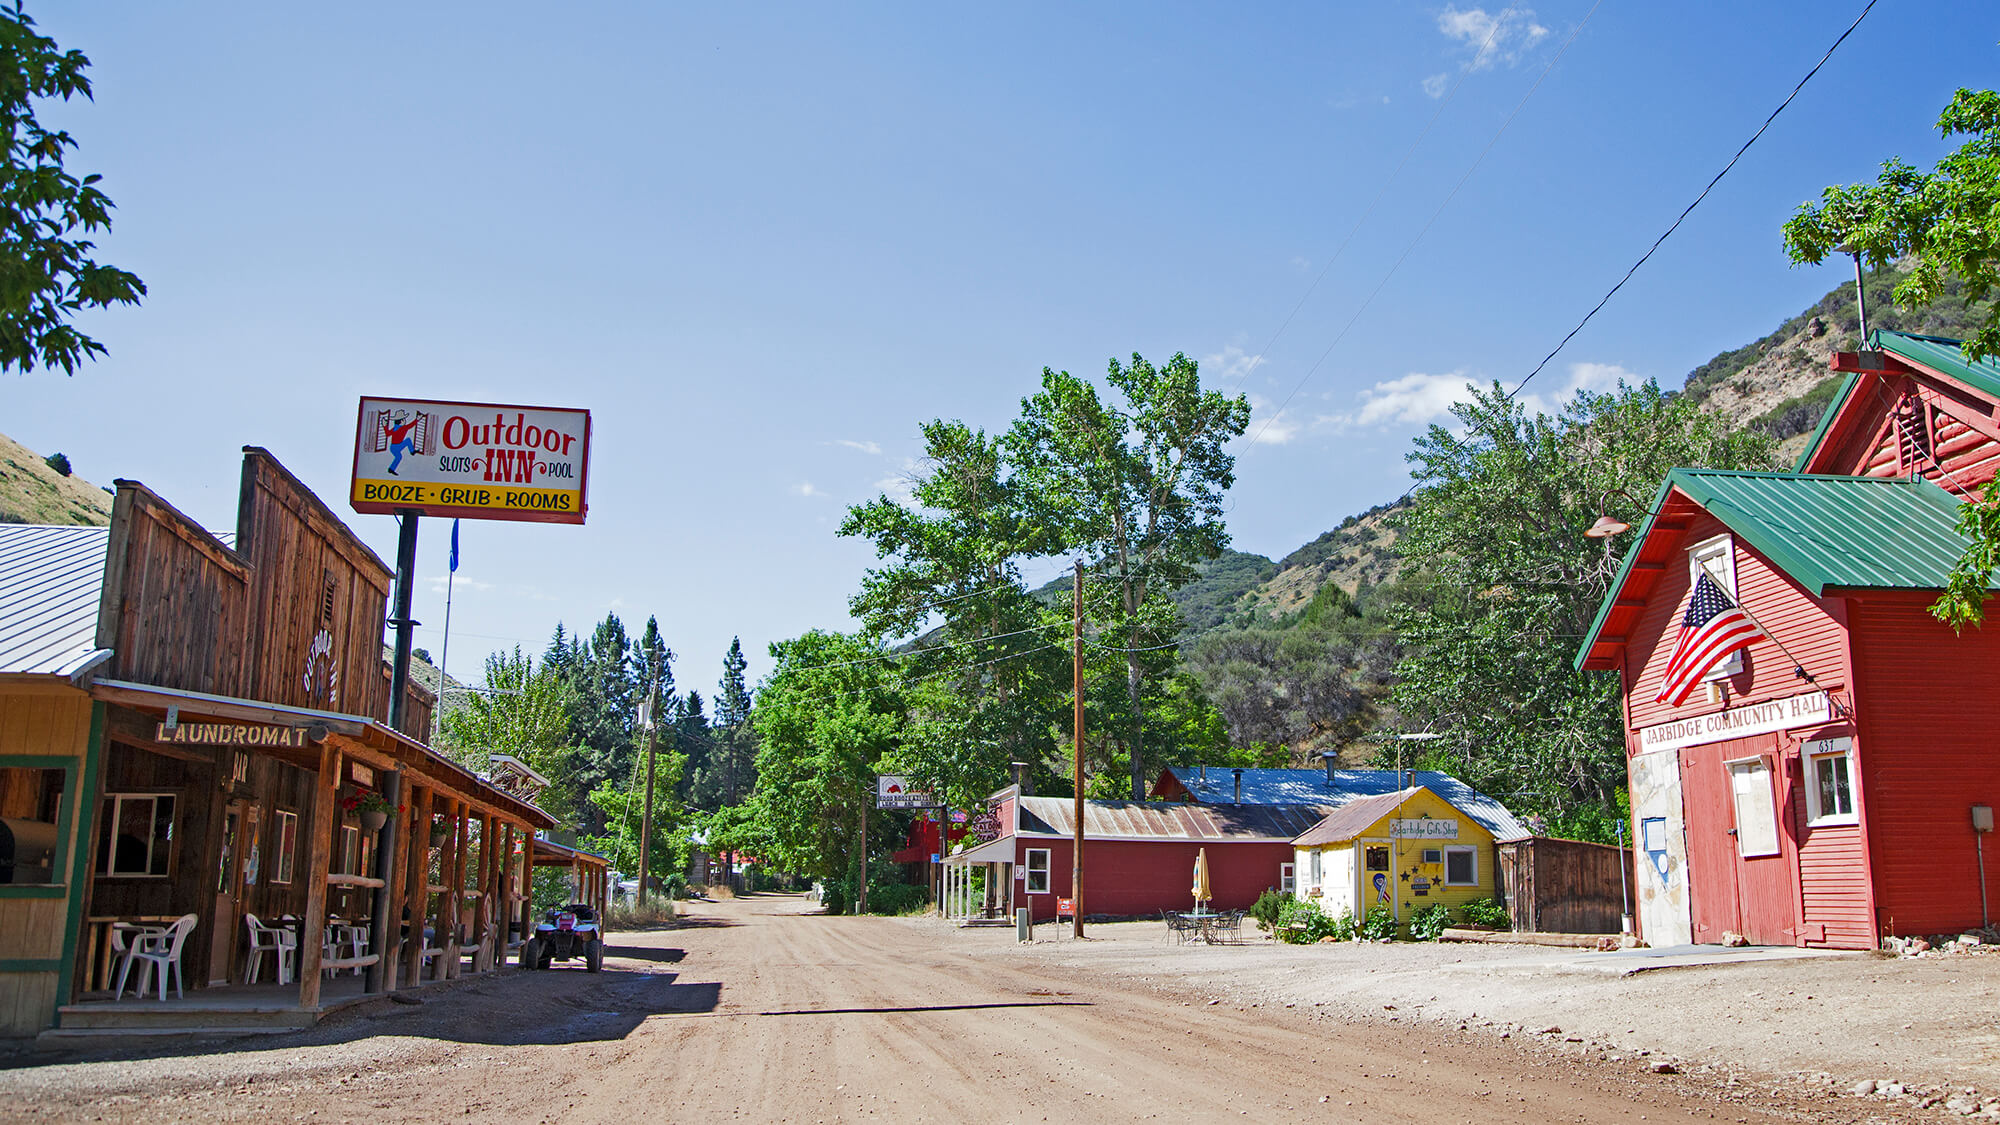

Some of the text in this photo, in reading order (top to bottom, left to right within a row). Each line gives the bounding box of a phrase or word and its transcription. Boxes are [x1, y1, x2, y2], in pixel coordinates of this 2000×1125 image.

[443, 413, 576, 456] Outdoor
[439, 448, 574, 483] SLOTS INN POOL
[364, 484, 570, 510] BOOZE GRUB ROOMS
[157, 722, 308, 747] LAUNDROMAT
[1646, 719, 1703, 745] JARBIDGE
[1706, 702, 1785, 732] COMMUNITY
[1790, 694, 1828, 717] HALL
[1818, 739, 1834, 752] 637
[232, 751, 248, 783] BAR
